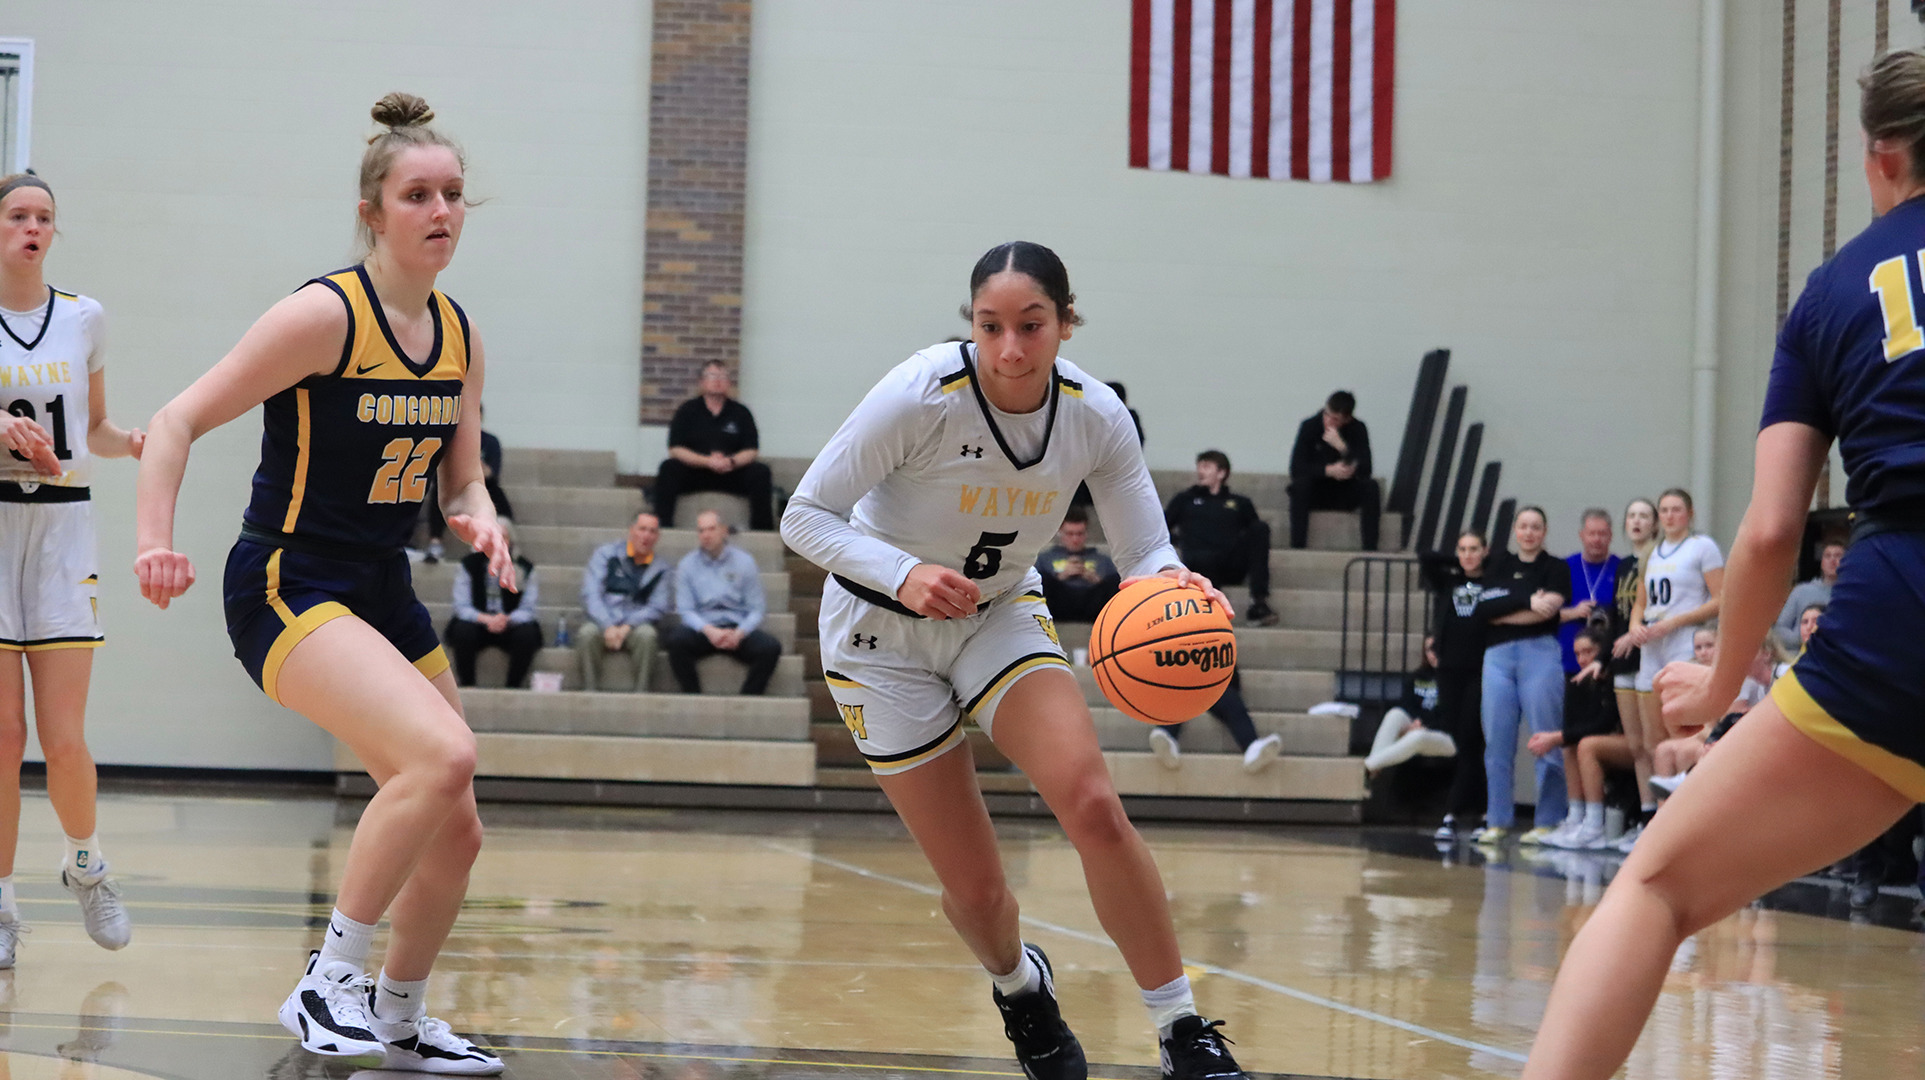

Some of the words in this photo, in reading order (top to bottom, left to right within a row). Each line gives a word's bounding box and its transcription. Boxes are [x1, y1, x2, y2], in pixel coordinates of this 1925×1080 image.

[1868, 248, 1925, 363] 1
[0, 361, 72, 388] WAYNE
[356, 393, 462, 425] CONCORDI
[367, 437, 442, 504] 22
[958, 484, 1059, 517] WAYNE
[963, 530, 1019, 580] 5
[1154, 641, 1234, 673] Wilson
